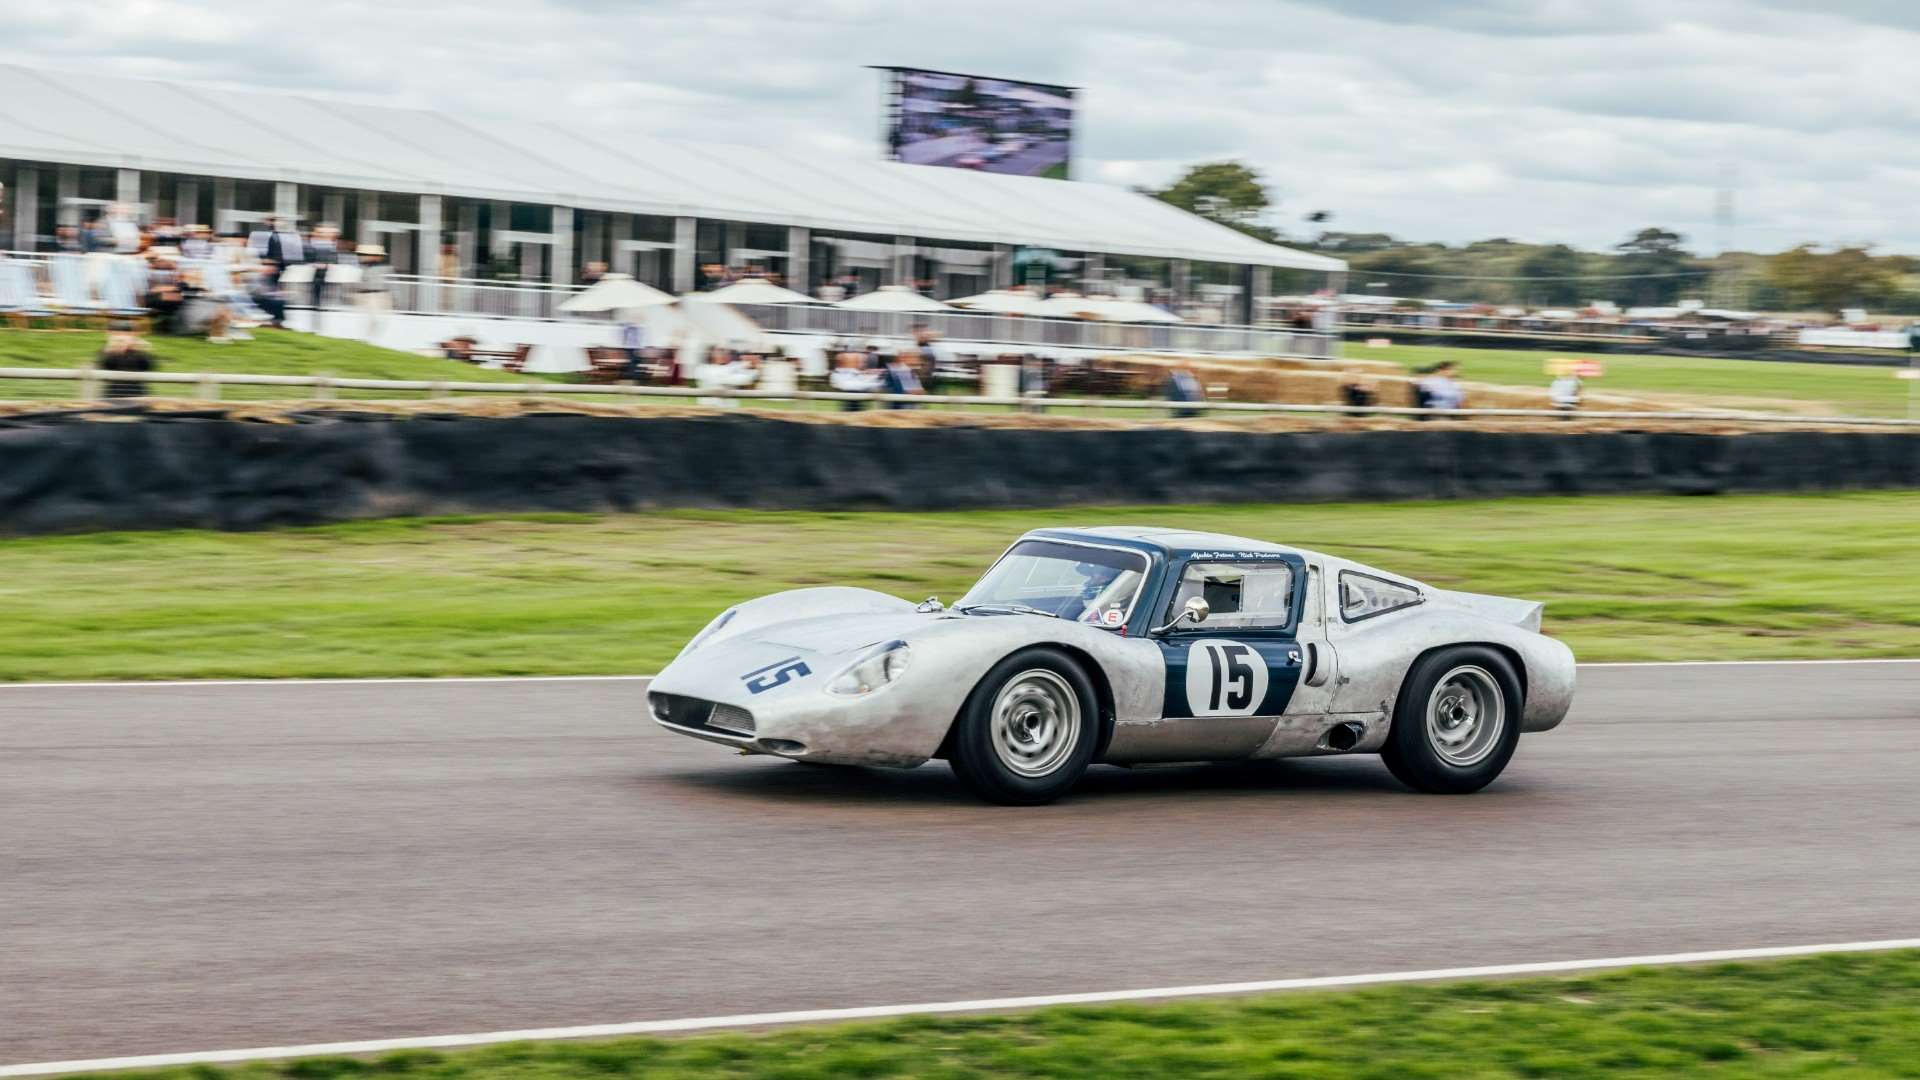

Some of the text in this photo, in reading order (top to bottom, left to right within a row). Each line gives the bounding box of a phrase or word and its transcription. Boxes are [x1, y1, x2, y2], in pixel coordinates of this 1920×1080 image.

[1108, 612, 1118, 622] E
[740, 655, 813, 695] 15
[1205, 646, 1254, 710] 15
